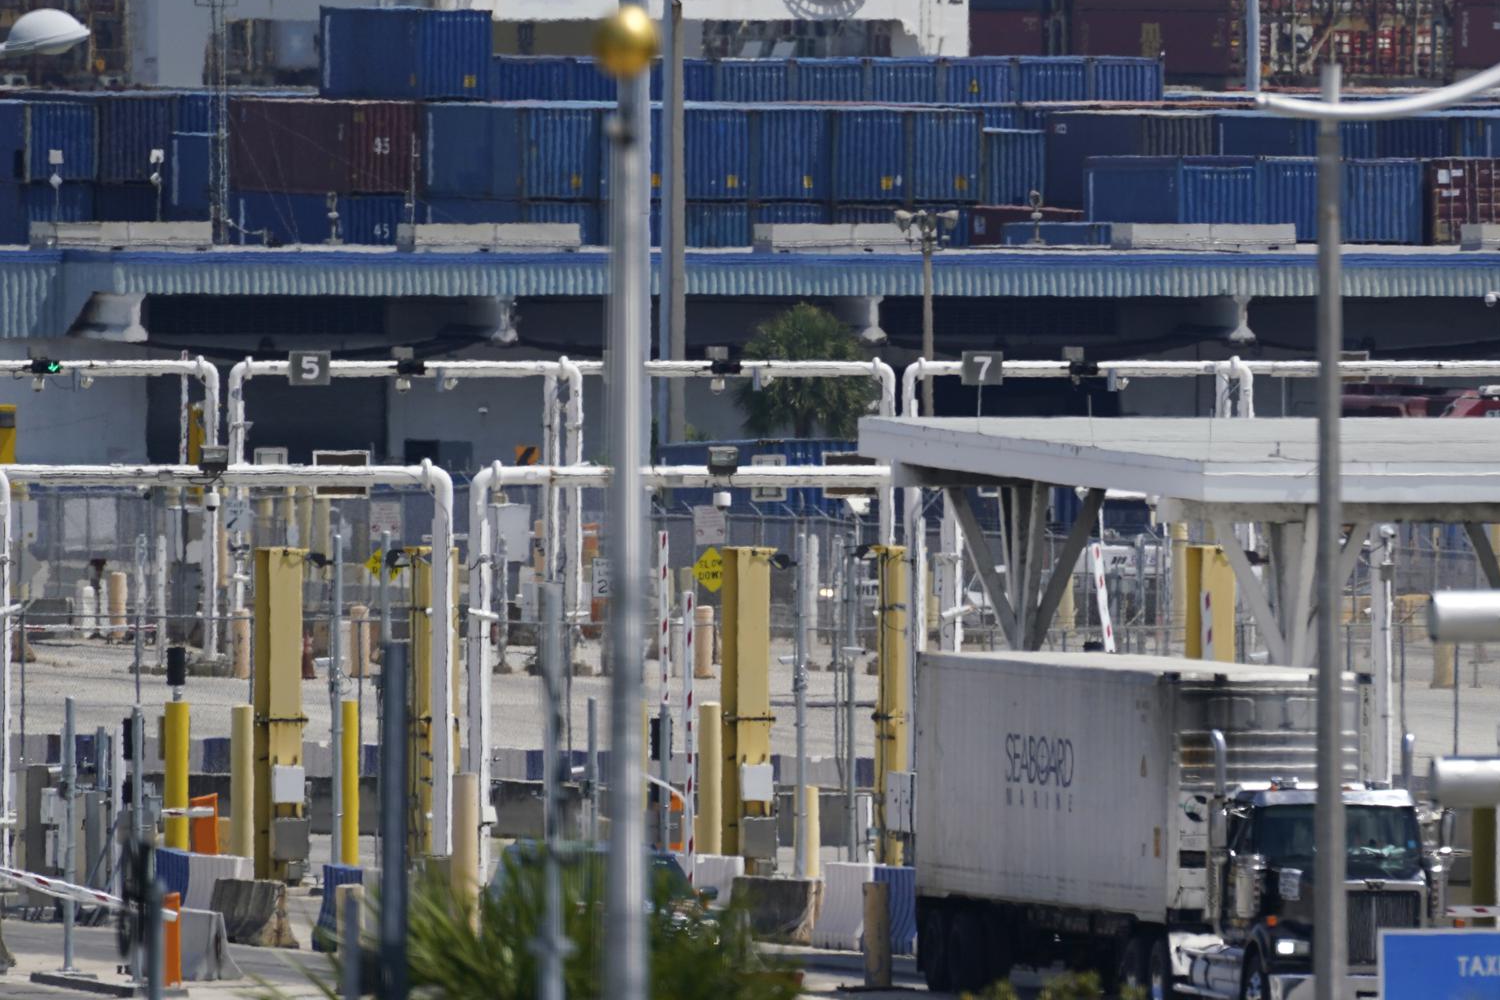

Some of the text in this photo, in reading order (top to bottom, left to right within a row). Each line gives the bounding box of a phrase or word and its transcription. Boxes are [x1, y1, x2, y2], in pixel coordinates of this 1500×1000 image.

[373, 136, 391, 155] 45
[373, 223, 391, 239] 45
[301, 356, 319, 380] 5
[973, 355, 992, 381] 7
[1004, 732, 1074, 788] SEABOARD
